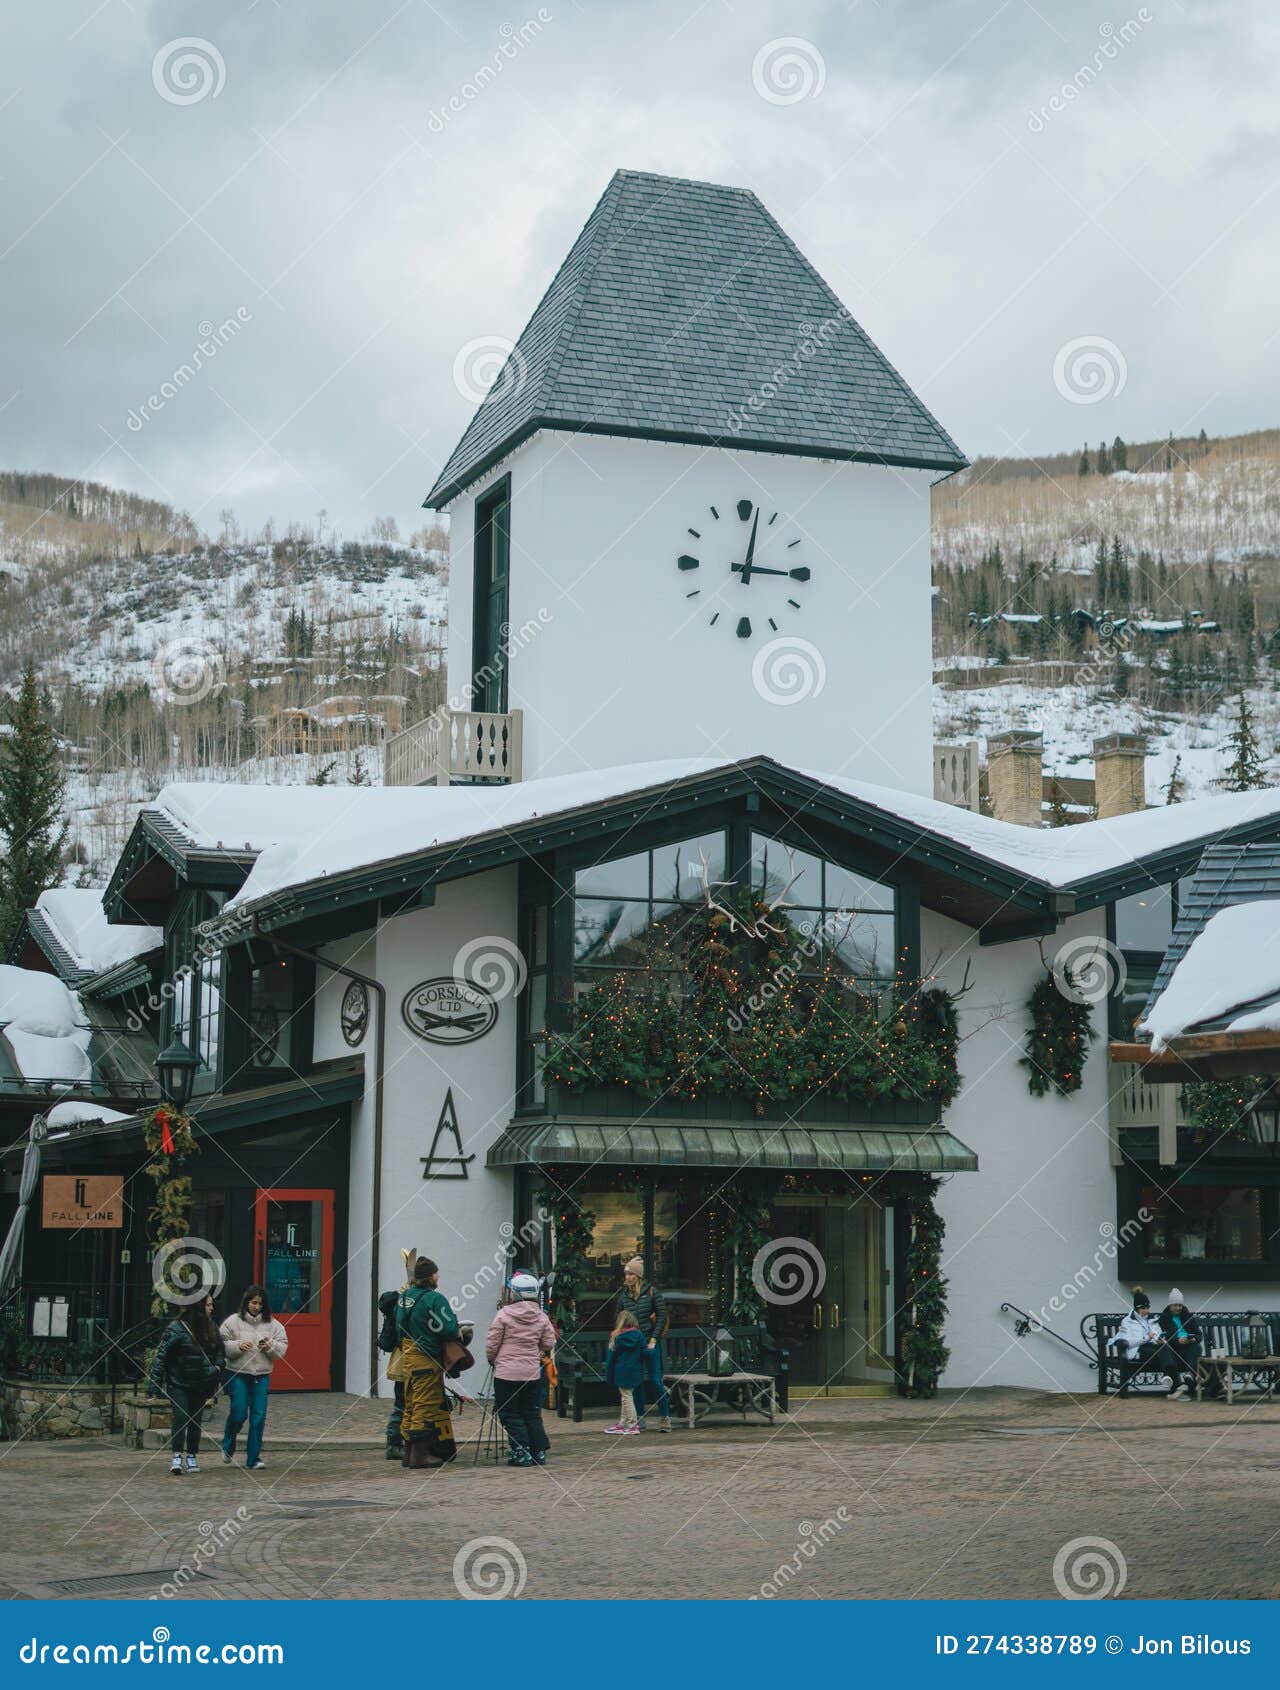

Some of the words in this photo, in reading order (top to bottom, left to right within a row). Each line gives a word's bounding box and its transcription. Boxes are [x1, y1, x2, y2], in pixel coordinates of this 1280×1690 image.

[439, 1001, 462, 1012] LTD
[51, 1211, 82, 1221] FALL
[87, 1211, 114, 1220] LINE
[267, 1249, 293, 1257] FALL
[295, 1249, 318, 1257] LINE
